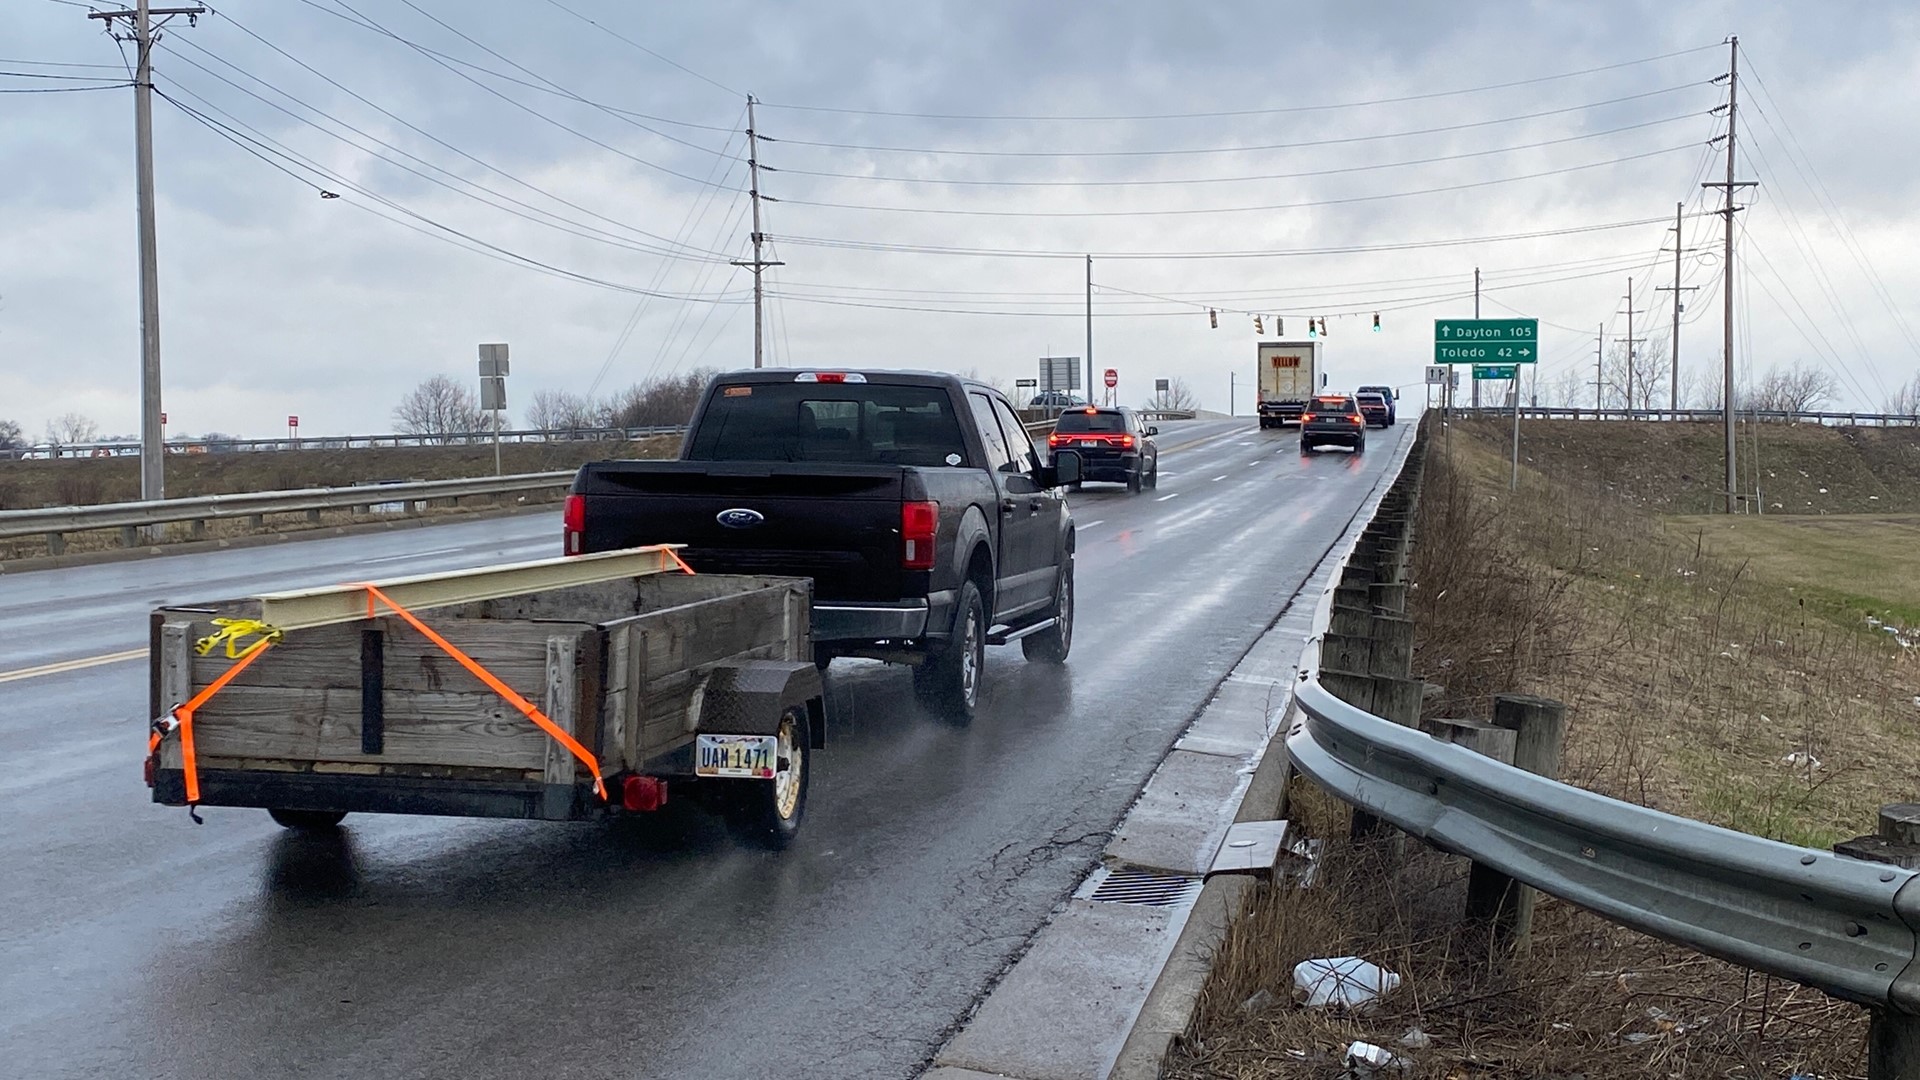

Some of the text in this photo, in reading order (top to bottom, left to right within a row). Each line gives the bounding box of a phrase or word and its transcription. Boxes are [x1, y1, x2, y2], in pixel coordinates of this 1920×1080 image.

[1456, 327, 1531, 339] Dayton 105
[1441, 347, 1512, 357] Toledo 42
[735, 748, 768, 769] 1471
